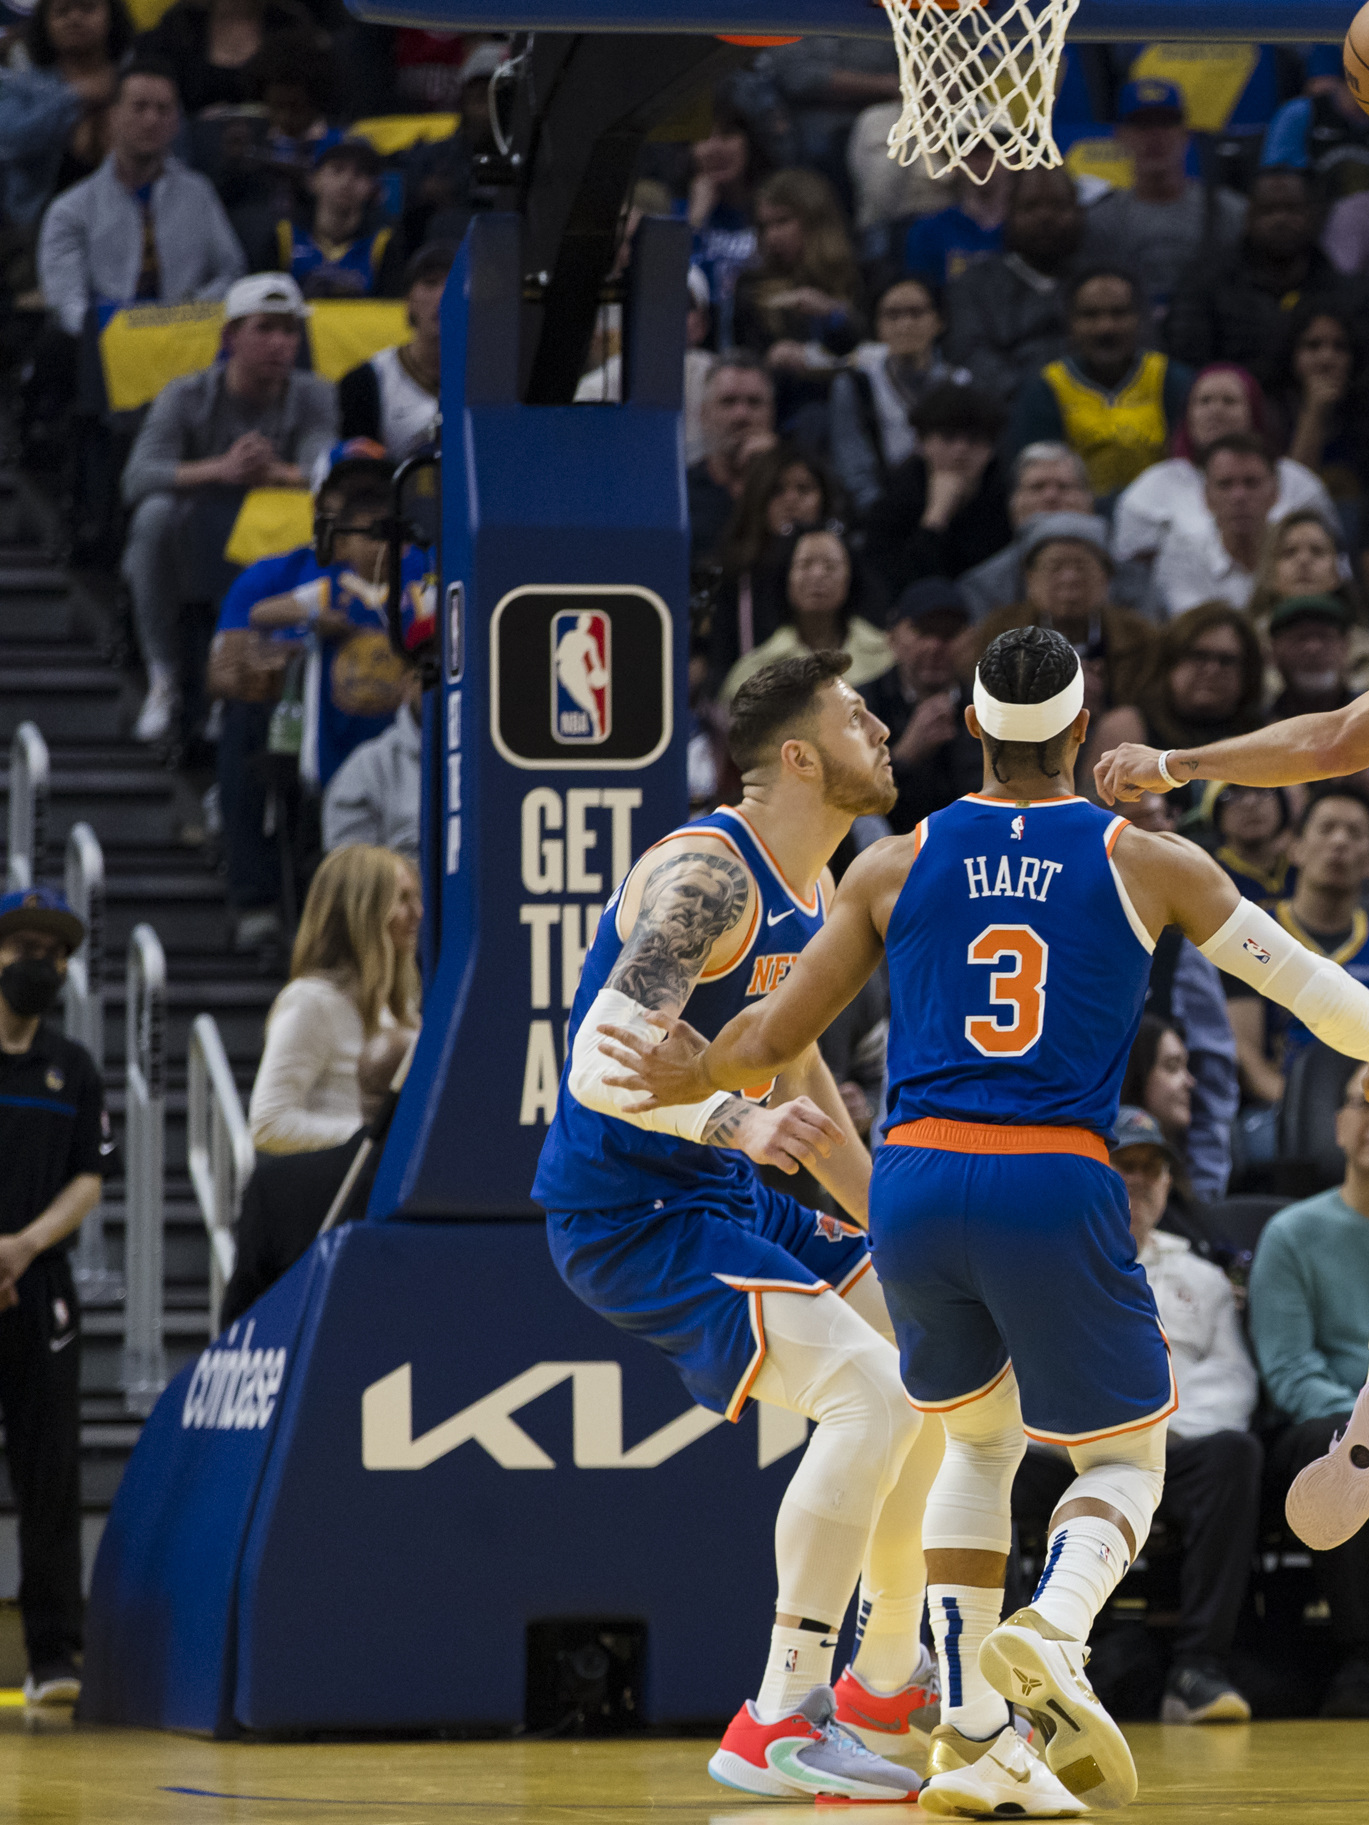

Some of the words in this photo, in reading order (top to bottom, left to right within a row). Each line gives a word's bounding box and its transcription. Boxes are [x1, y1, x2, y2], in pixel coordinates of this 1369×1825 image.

[521, 786, 643, 895] GET
[963, 855, 1064, 902] HART
[519, 903, 605, 1009] TH
[964, 923, 1049, 1057] 3
[182, 1317, 287, 1430] coinbase
